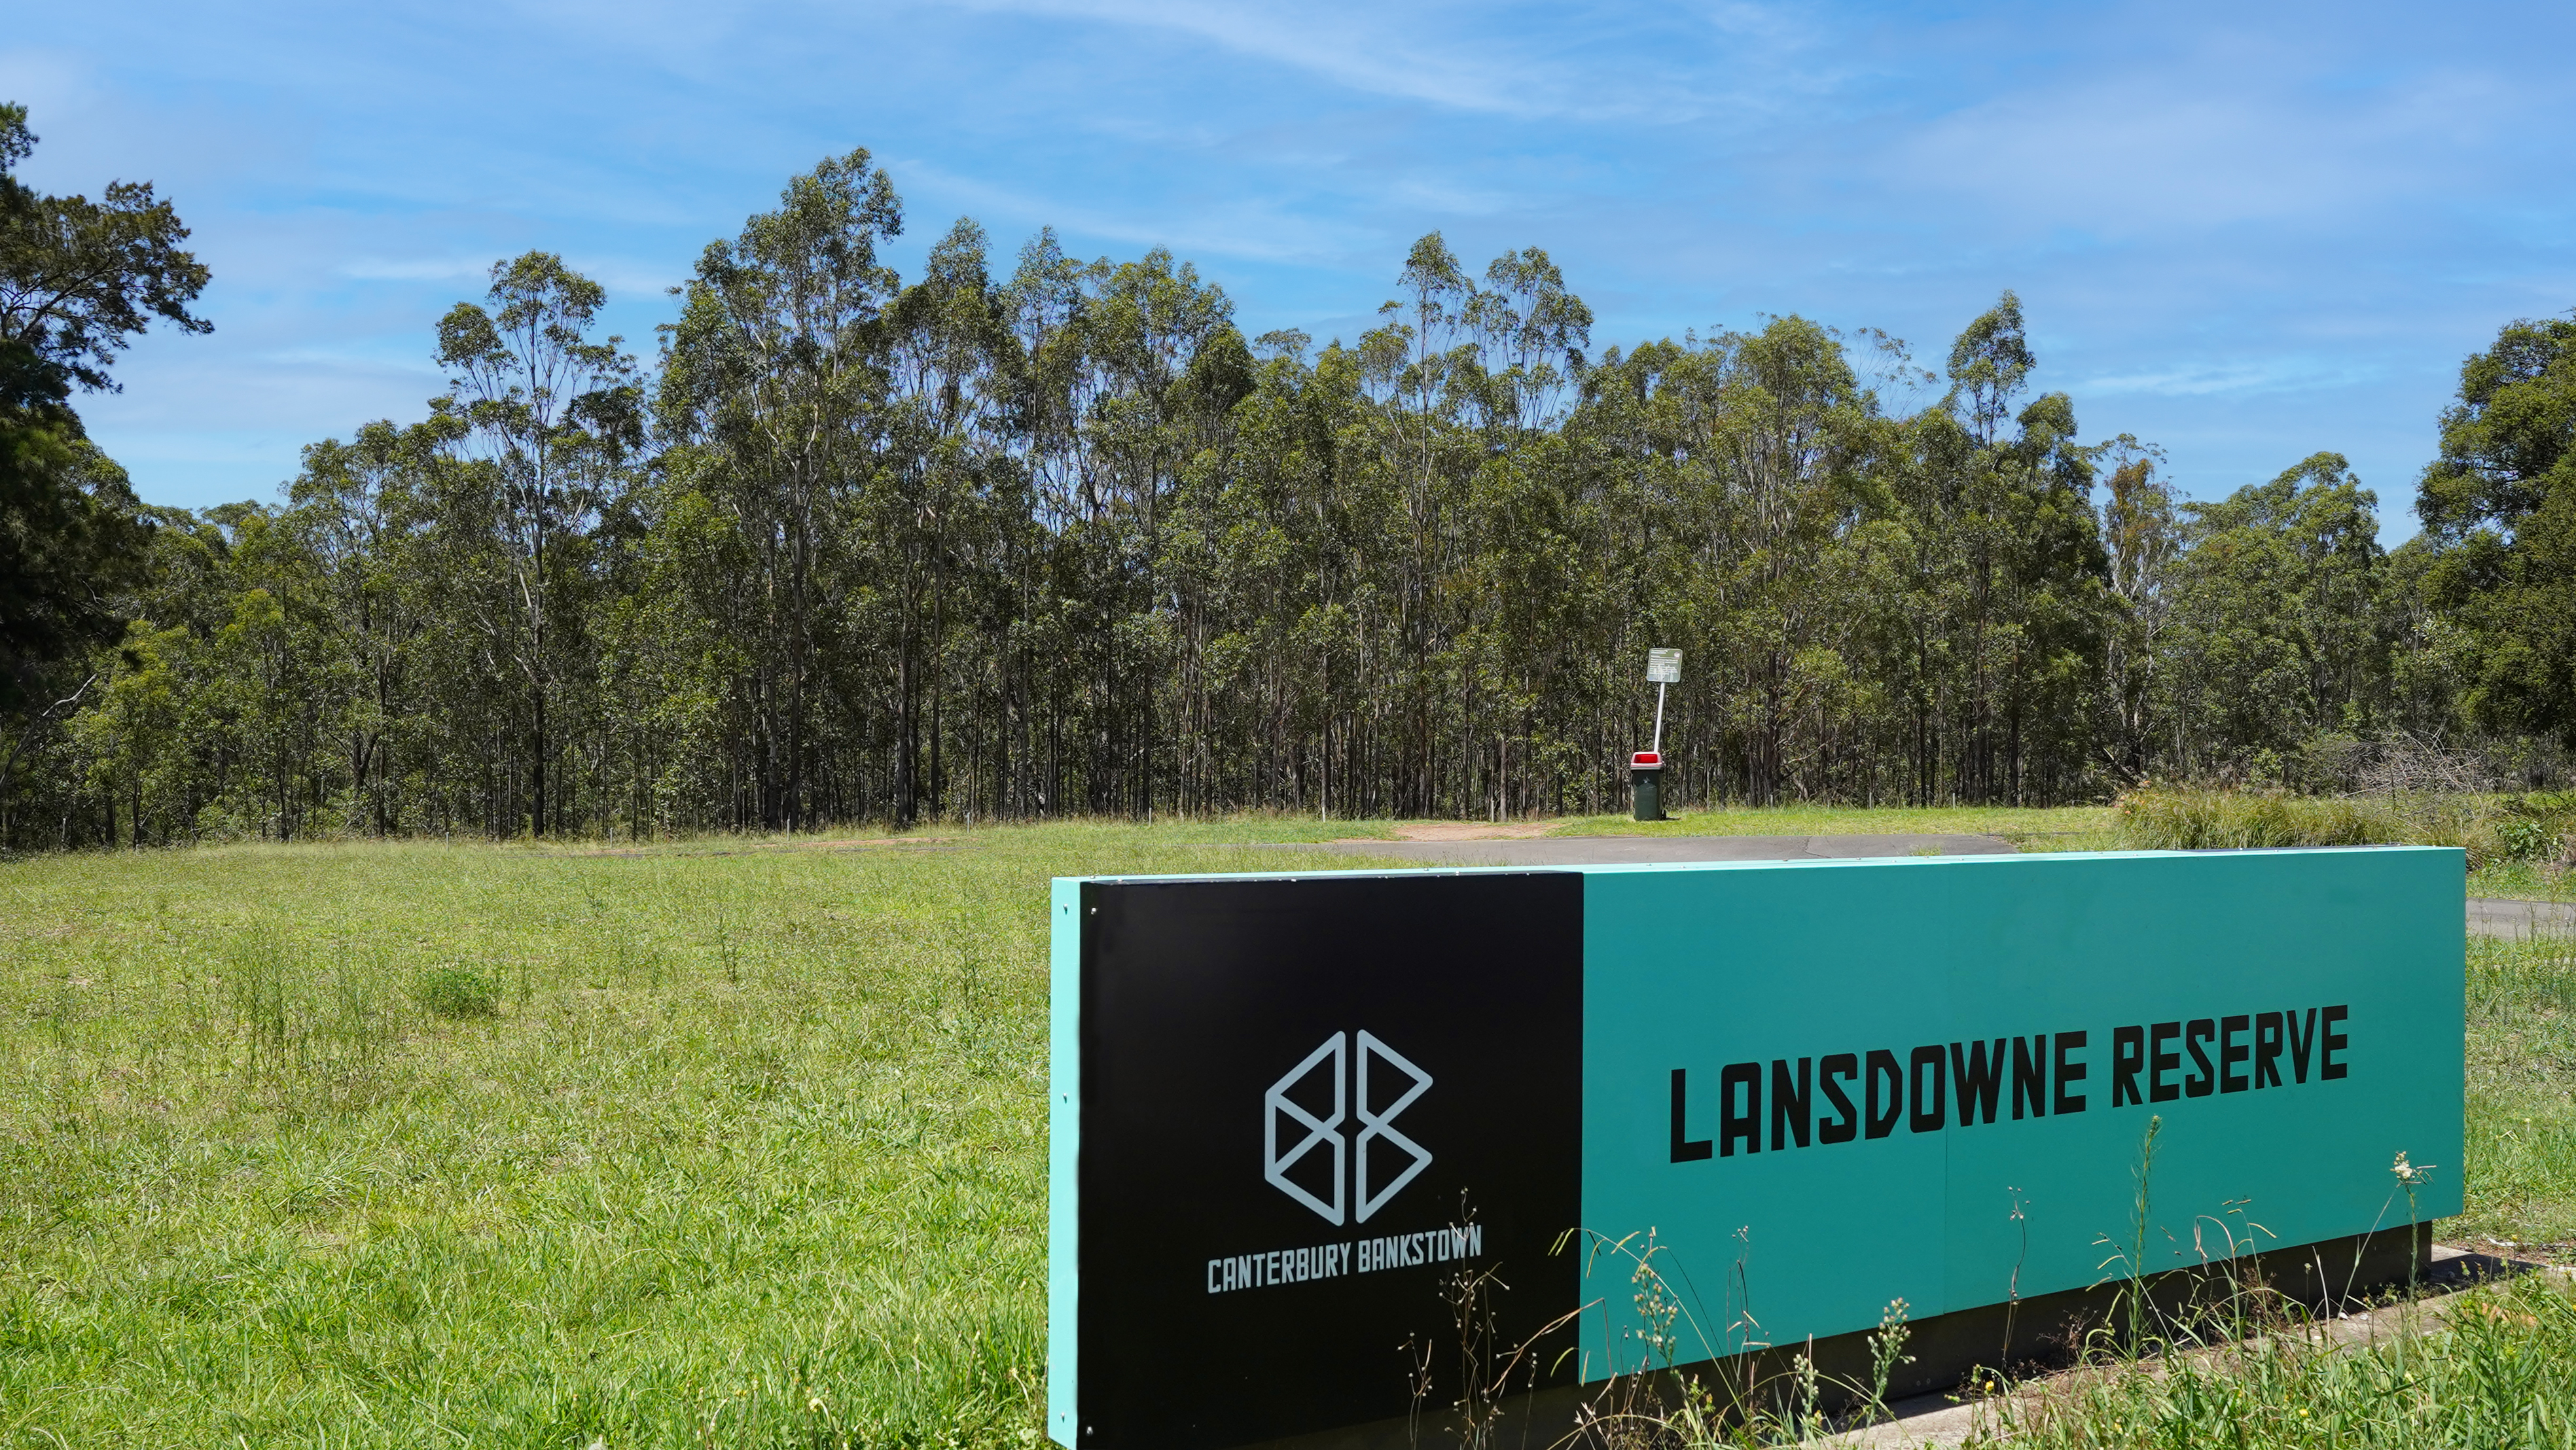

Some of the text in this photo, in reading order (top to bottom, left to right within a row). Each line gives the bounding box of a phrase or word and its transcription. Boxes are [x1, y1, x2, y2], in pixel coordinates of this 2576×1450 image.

[1670, 1004, 2348, 1163] LANSDOWNE RESERVE
[1208, 1225, 1482, 1294] CANTERBURY BANKSTOWN
